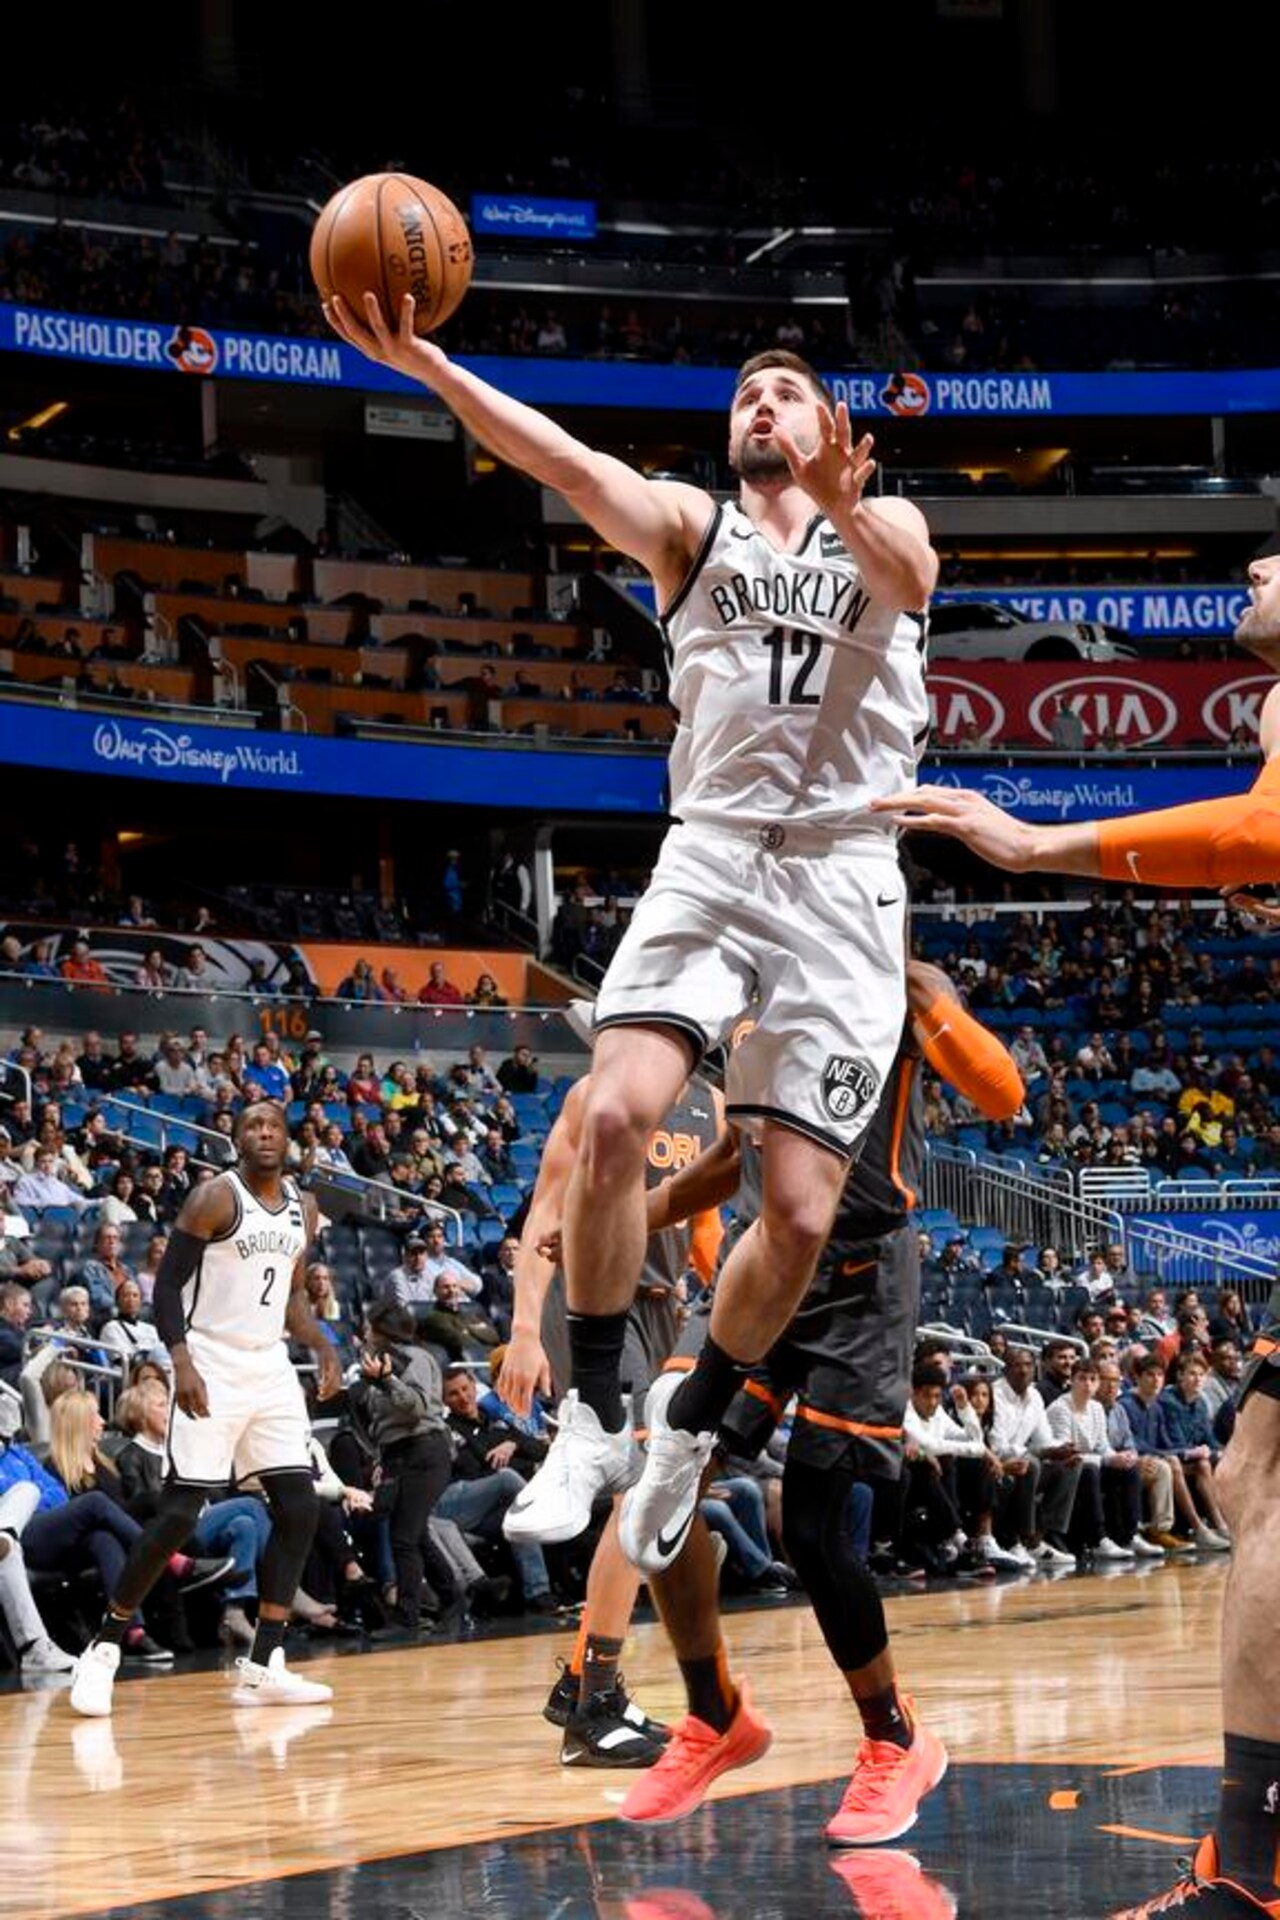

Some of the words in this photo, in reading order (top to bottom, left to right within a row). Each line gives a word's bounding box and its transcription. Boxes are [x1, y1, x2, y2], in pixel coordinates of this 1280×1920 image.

[14, 311, 163, 362] PASSHOLDER
[224, 337, 342, 381] PROGRAM
[935, 378, 1053, 410] PROGRAM
[710, 573, 872, 634] BROOKLYN
[1097, 598, 1136, 629] OF
[1142, 594, 1247, 629] MAGIC
[762, 626, 823, 706] 12
[926, 694, 978, 735] IA
[235, 746, 299, 775] World
[1073, 783, 1134, 807] World
[259, 1007, 306, 1040] 116
[826, 1058, 875, 1101] NETS
[260, 1266, 276, 1306] 2
